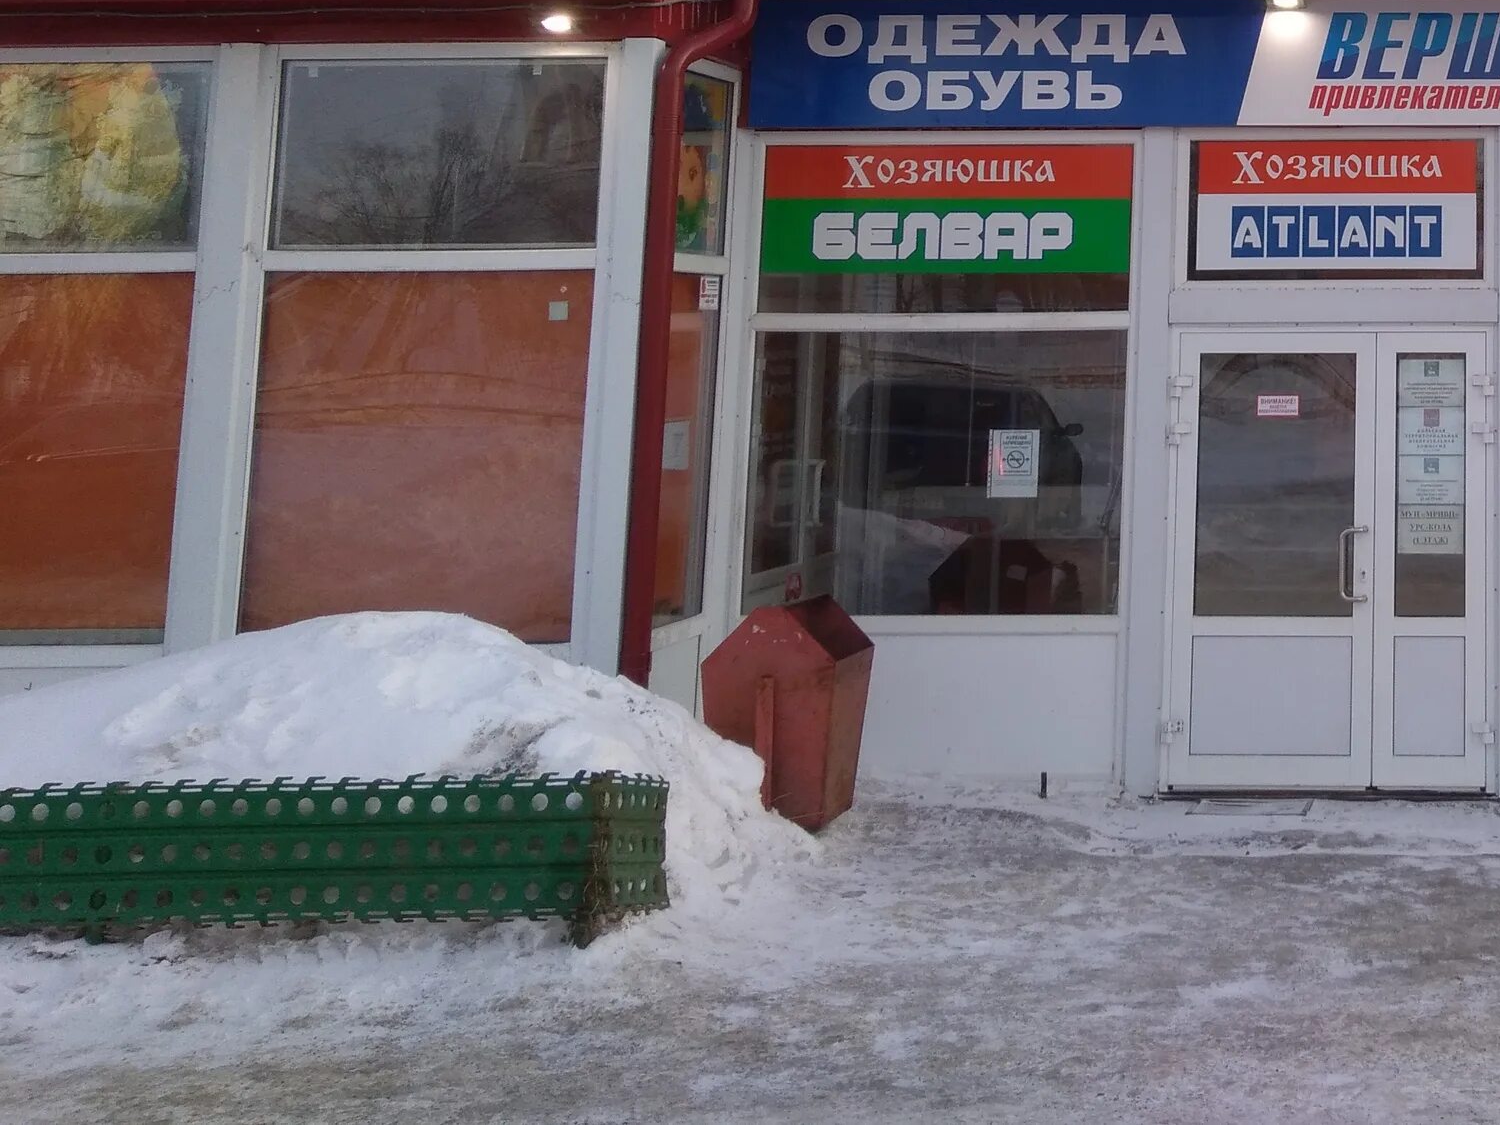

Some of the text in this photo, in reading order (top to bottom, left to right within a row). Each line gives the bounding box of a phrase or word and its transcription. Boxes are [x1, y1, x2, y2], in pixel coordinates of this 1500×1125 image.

[806, 13, 1187, 63] ОДЕЖДА
[867, 69, 1123, 113] ОБУВЬ
[842, 155, 1056, 189] Хозяюшка
[1232, 151, 1443, 185] Хозяюшка
[811, 211, 1074, 261] БЕЛВАР
[1231, 210, 1443, 255] ATLANT
